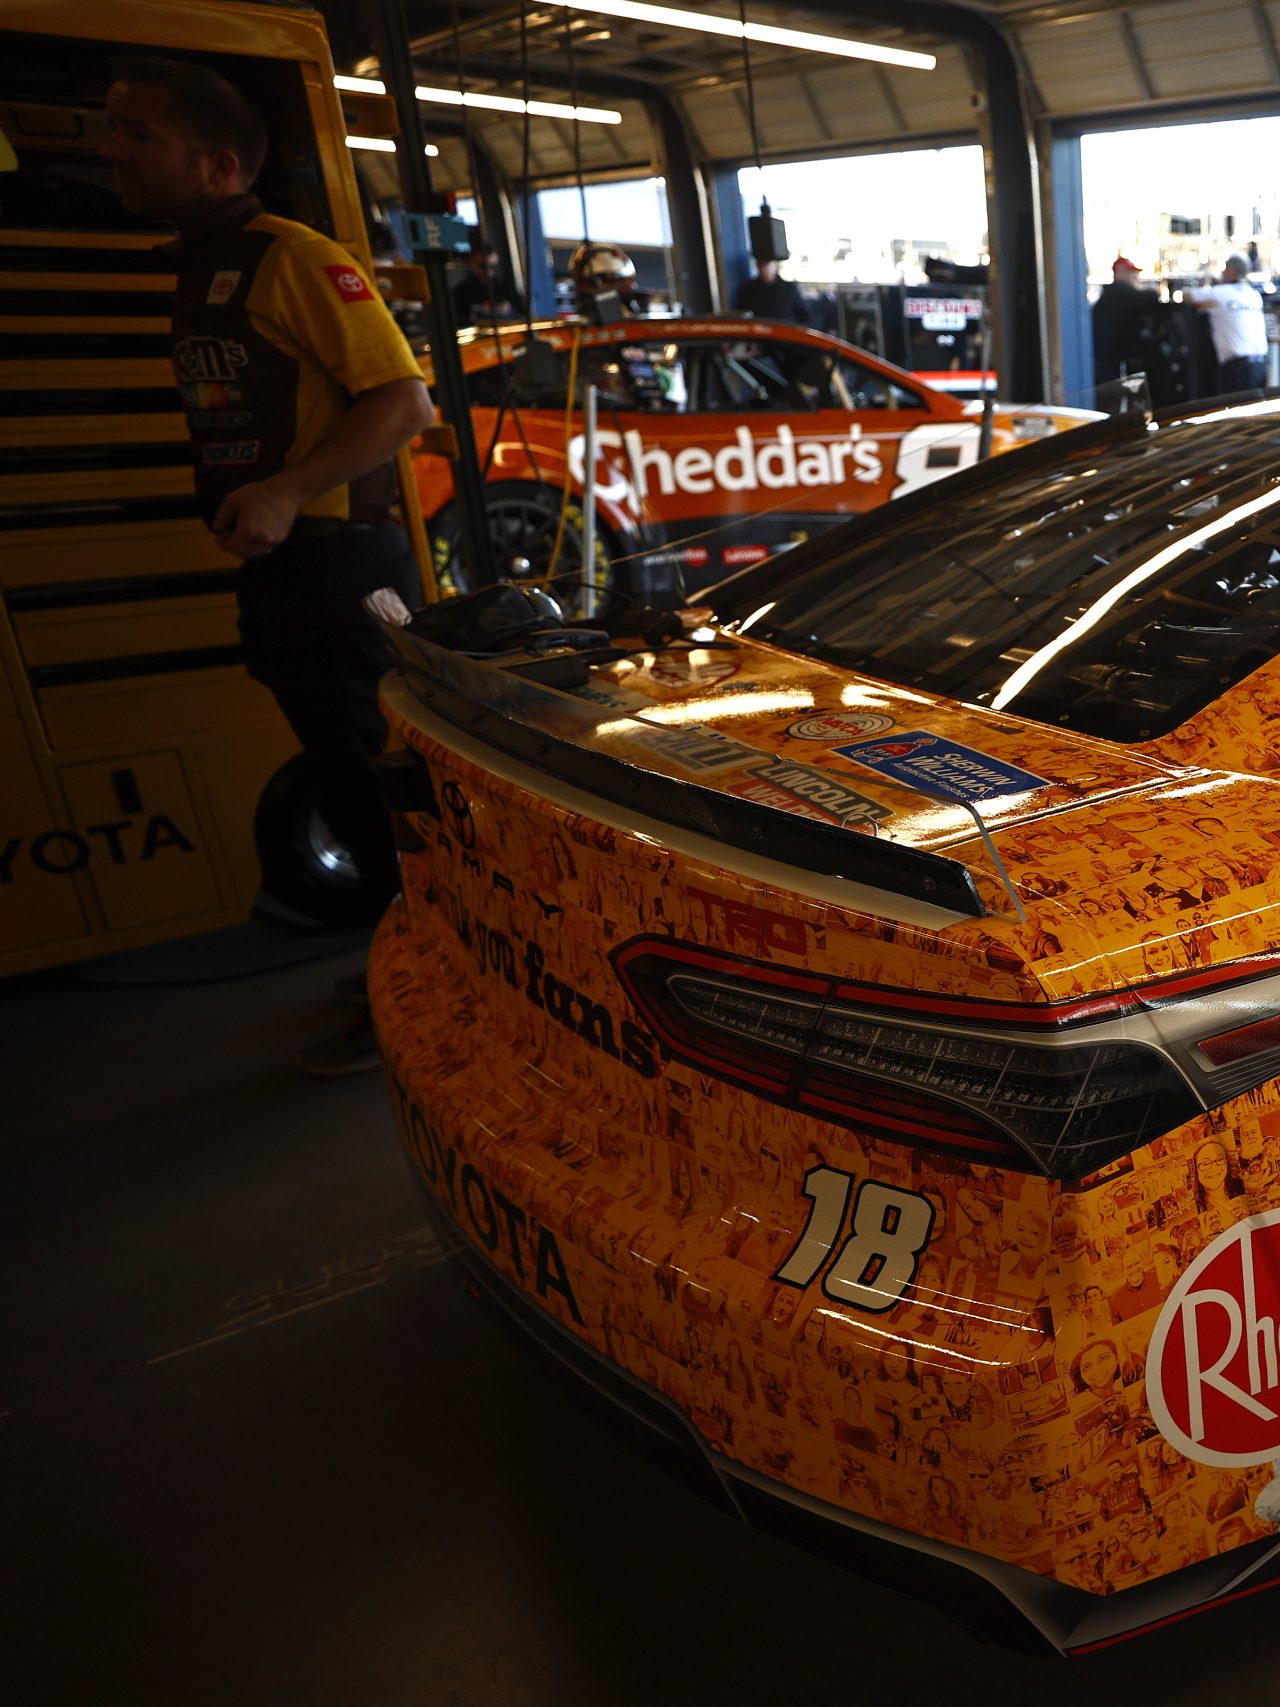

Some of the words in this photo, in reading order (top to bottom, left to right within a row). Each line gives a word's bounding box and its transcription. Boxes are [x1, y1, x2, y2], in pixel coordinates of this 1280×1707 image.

[568, 422, 884, 500] Cheddar's
[757, 765, 882, 822] LINCOLN
[905, 755, 993, 794] WILLIAMS
[932, 753, 1018, 786] SHERWIN
[743, 784, 828, 824] WELDE
[476, 917, 520, 989] you
[523, 940, 658, 1079] fans
[392, 1073, 587, 1329] TOYOTA
[772, 1164, 936, 1314] 18
